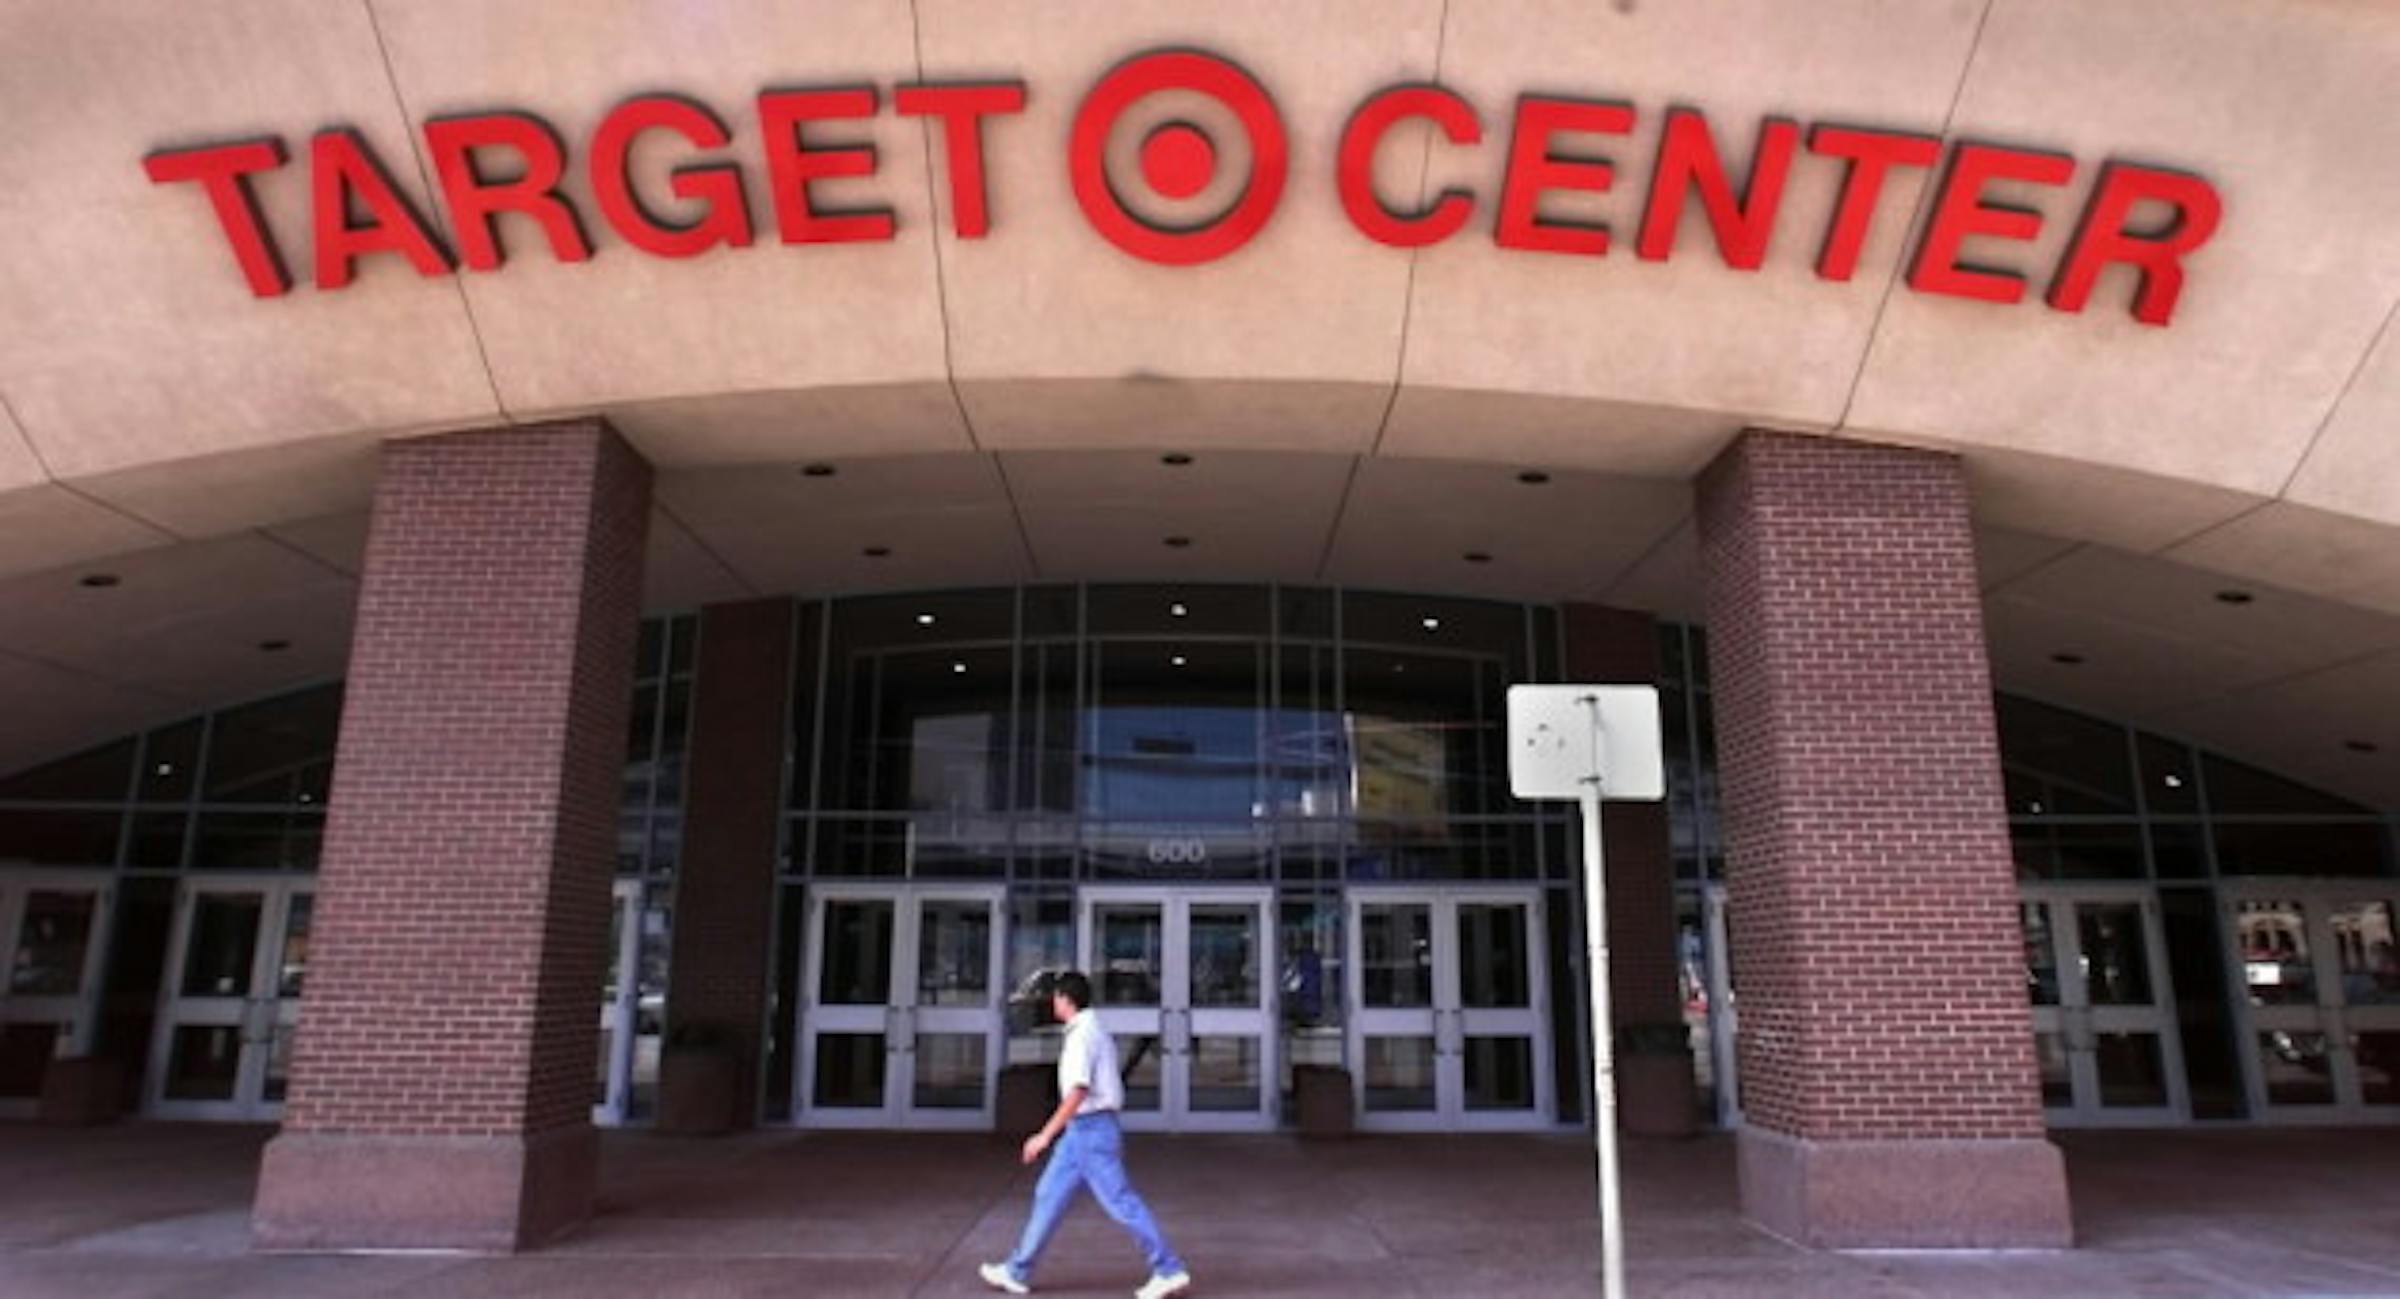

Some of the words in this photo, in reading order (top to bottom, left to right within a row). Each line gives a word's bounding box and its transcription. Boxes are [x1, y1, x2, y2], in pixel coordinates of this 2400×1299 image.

[142, 79, 1028, 299] TARGET
[1335, 84, 2222, 327] CENTER
[1148, 838, 1205, 863] 600
